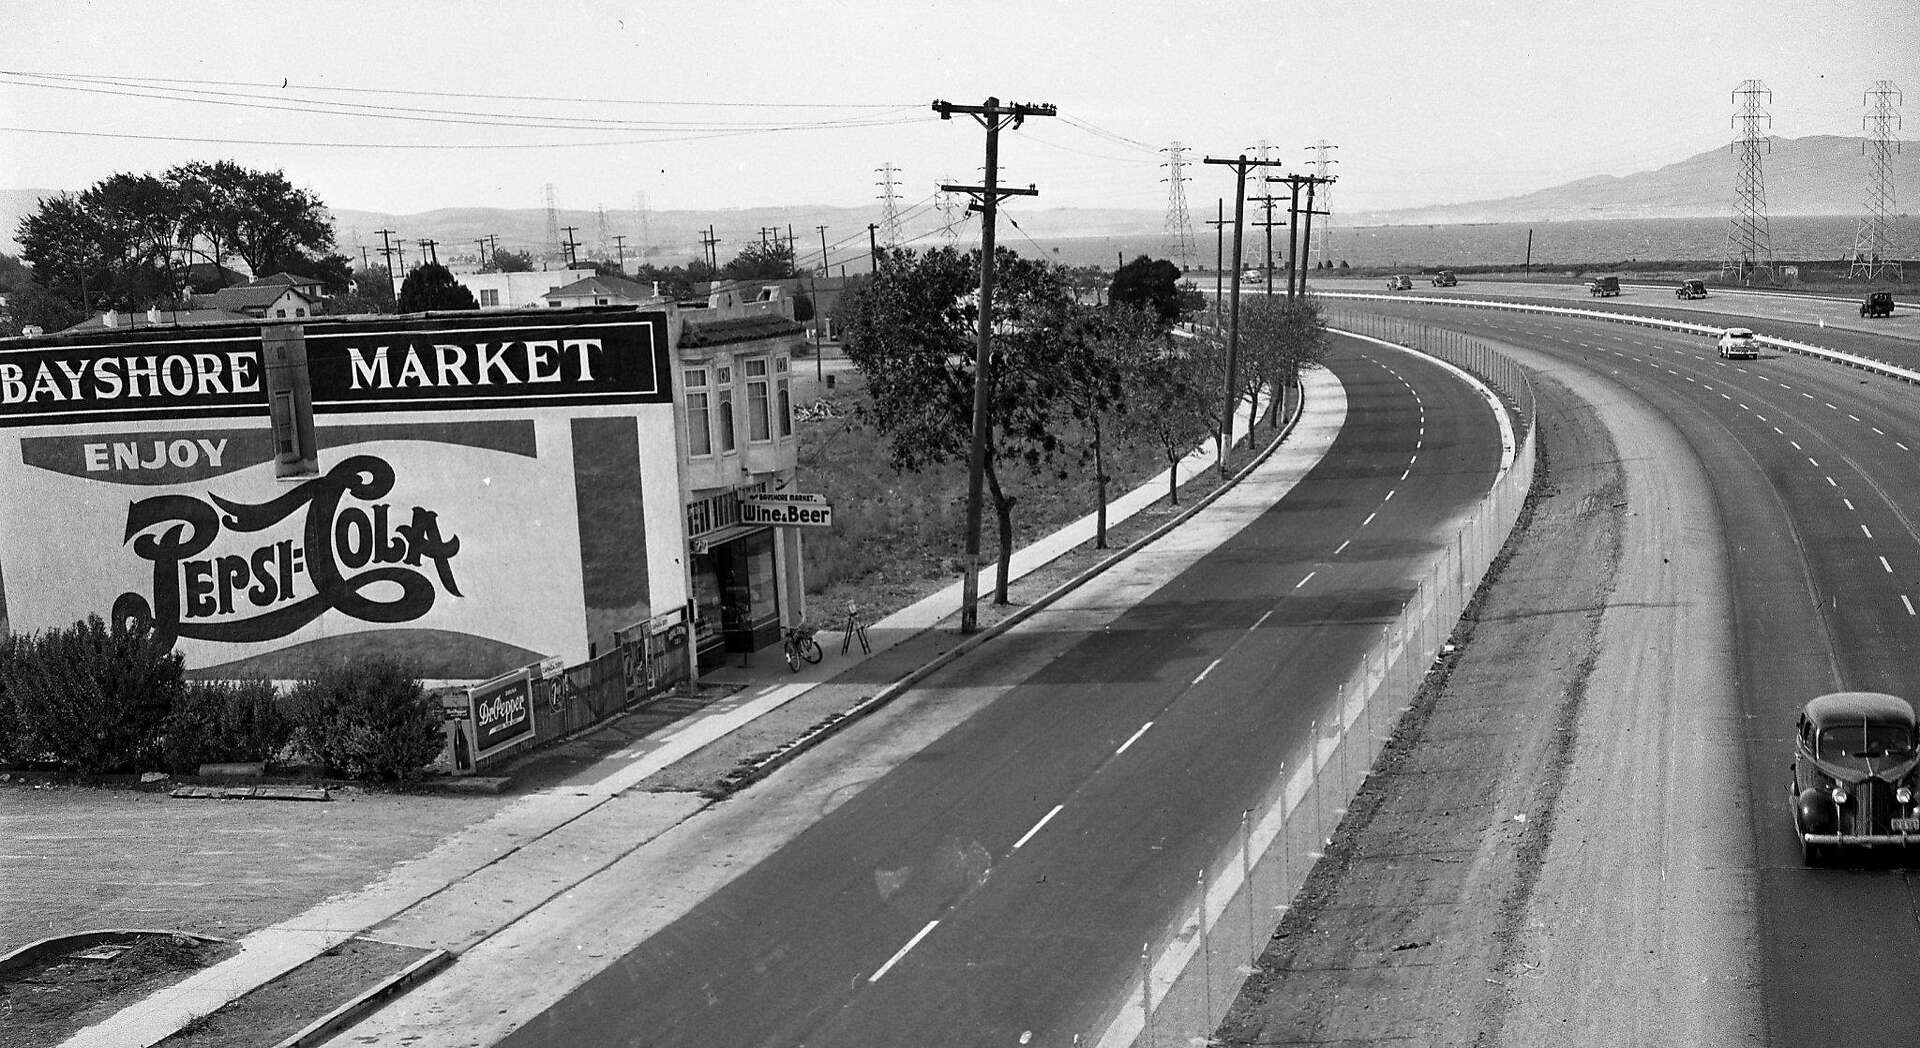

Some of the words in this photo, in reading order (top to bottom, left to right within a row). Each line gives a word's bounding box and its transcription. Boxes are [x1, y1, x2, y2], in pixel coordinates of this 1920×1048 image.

[0, 351, 260, 403] BAYSHORE
[347, 338, 602, 389] MARKET
[84, 439, 228, 471] ENJOY
